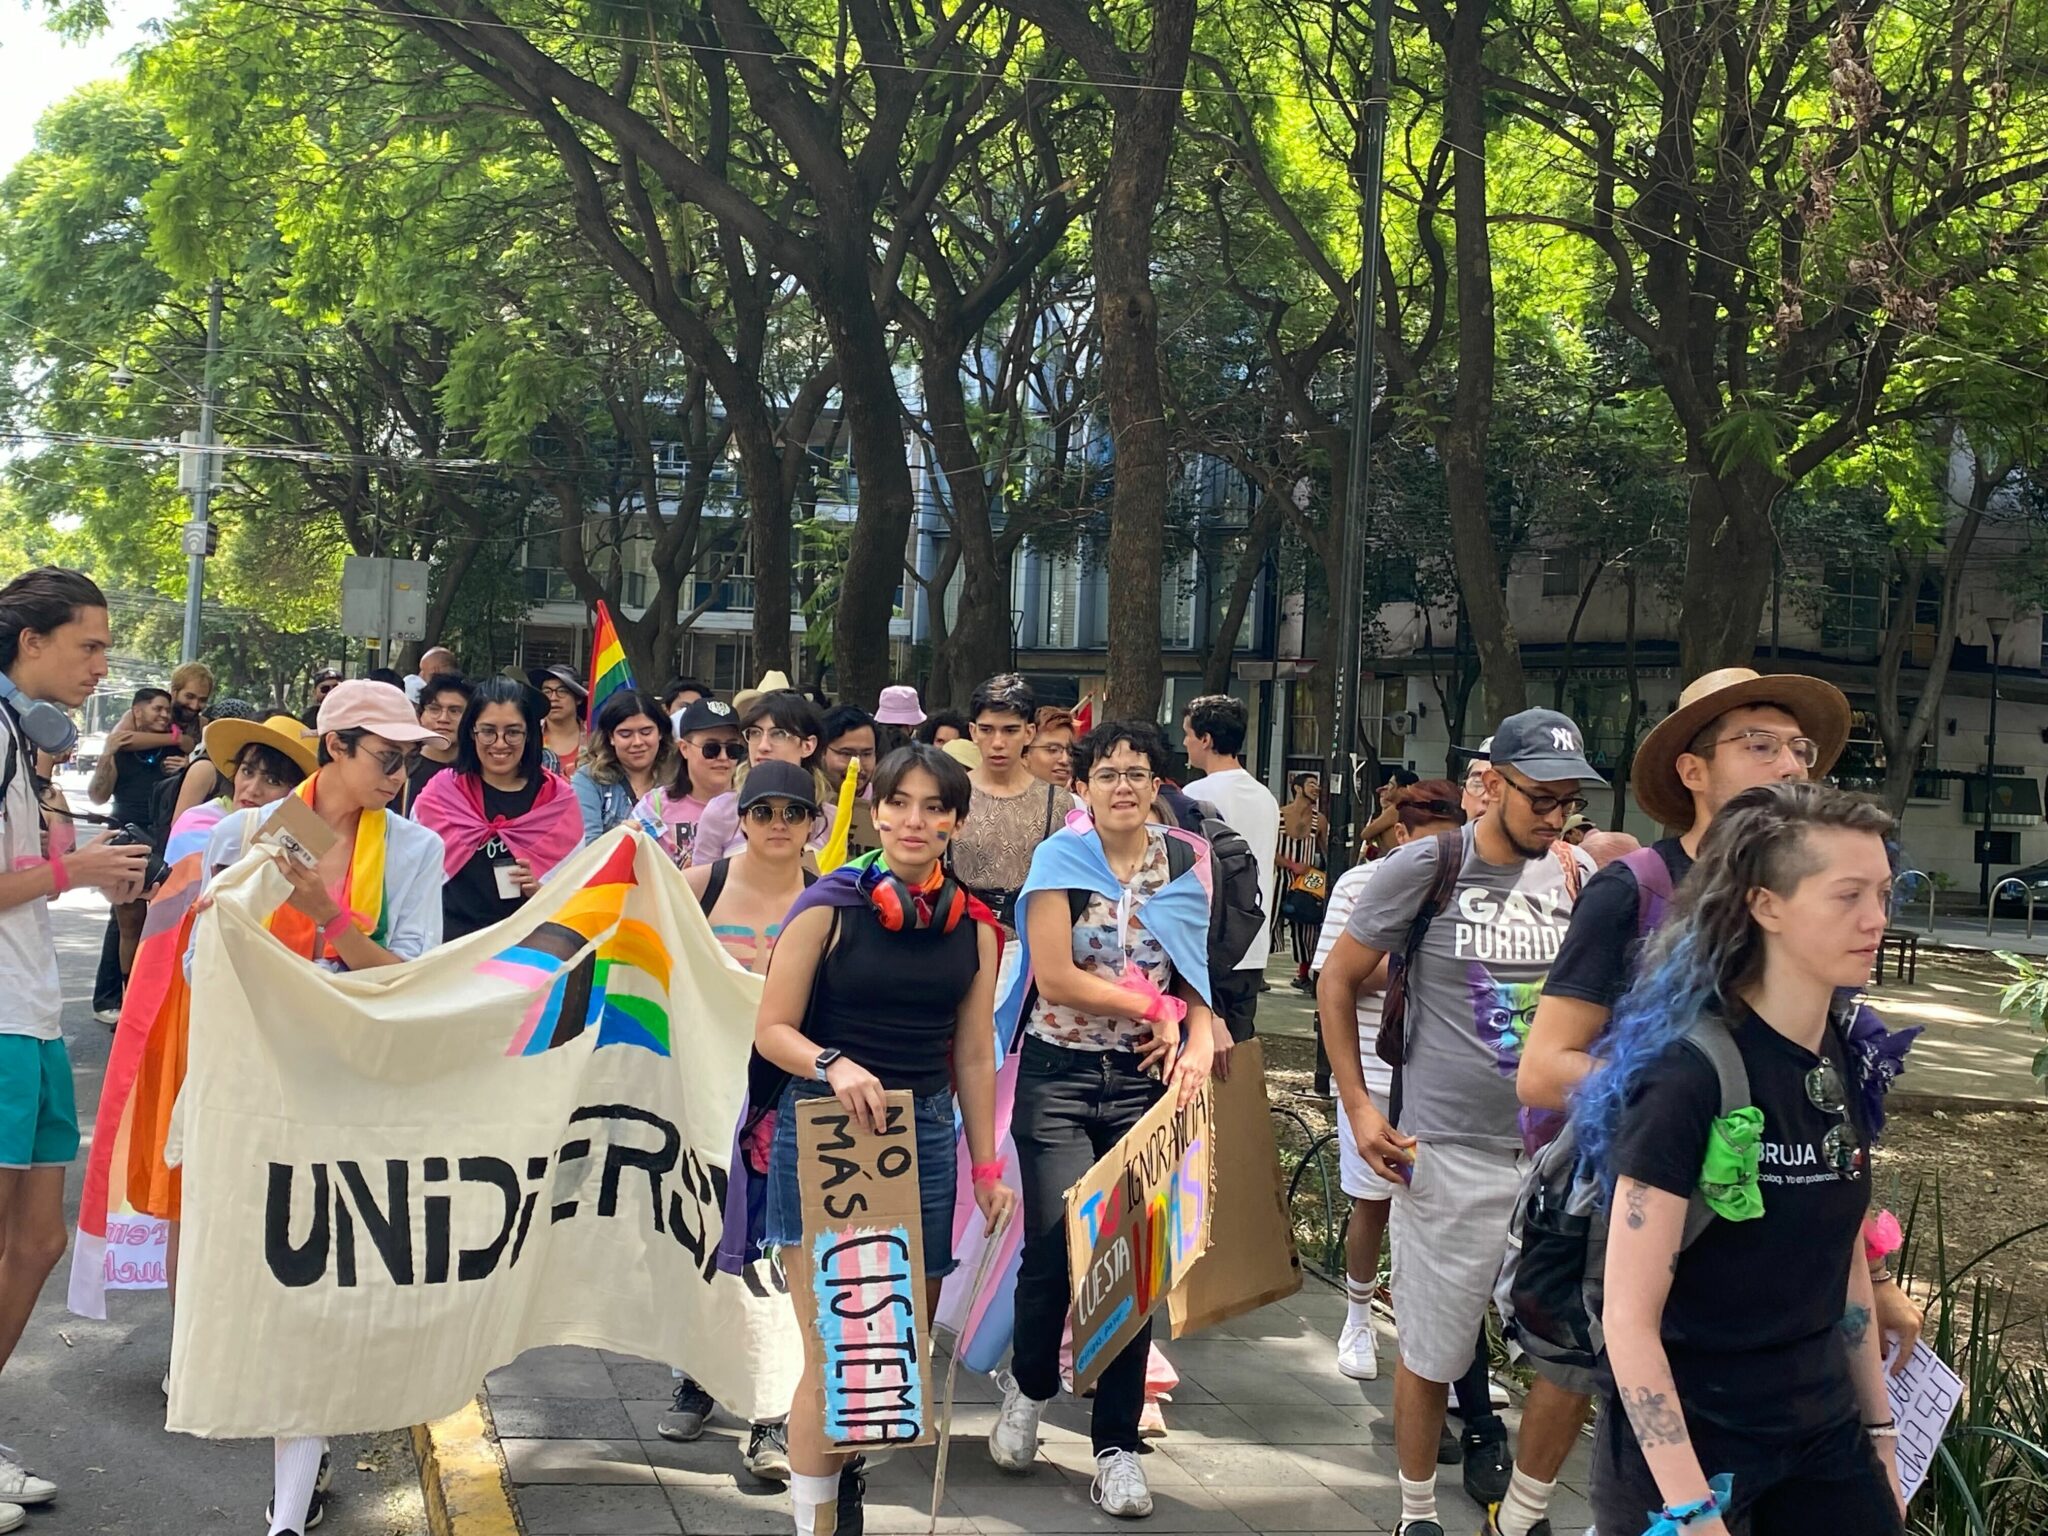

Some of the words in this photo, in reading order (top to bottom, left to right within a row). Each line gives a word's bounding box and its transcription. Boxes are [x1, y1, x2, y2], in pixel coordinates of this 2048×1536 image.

[1458, 887, 1559, 925] GAY
[811, 1114, 873, 1219] MÁS
[874, 1106, 912, 1178] NO
[1757, 1142, 1817, 1167] BRUJA
[1078, 1236, 1130, 1326] CUESTA
[821, 1234, 921, 1448] CIS-TEMA
[1914, 1362, 1960, 1433] LAS
